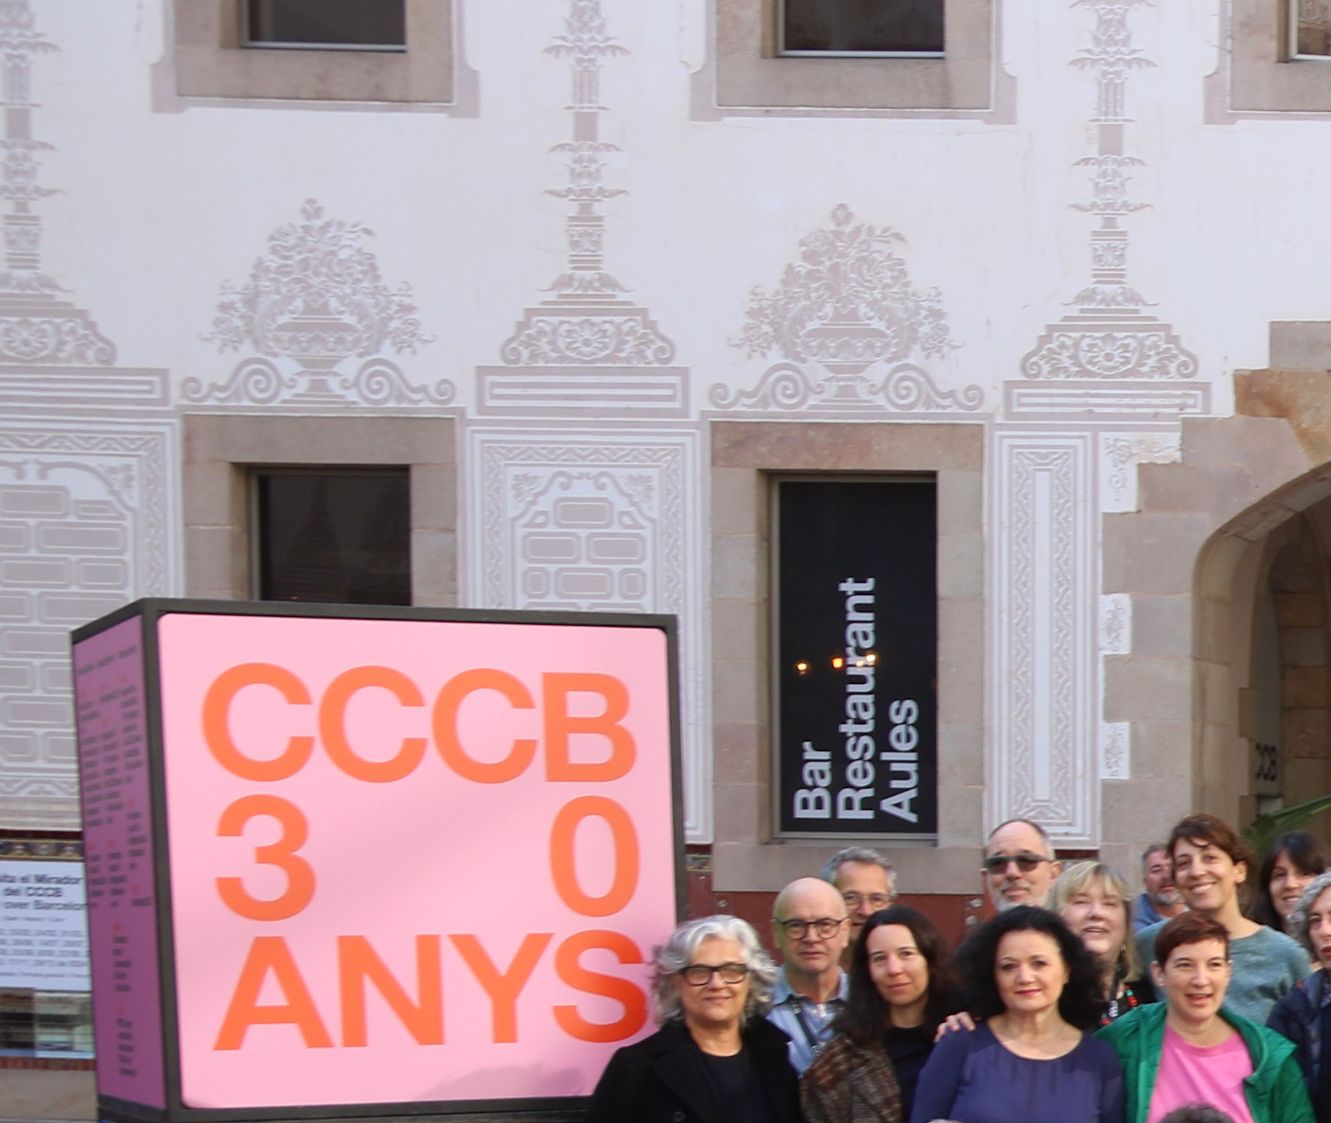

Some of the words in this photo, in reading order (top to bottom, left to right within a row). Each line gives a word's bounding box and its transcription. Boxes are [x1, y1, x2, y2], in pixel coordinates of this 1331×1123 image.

[201, 662, 638, 784] CCCB
[837, 577, 876, 820] Restaurant
[793, 741, 832, 819] Bar
[880, 698, 919, 823] Aules
[215, 794, 317, 921] 3
[549, 795, 640, 918] 0
[212, 929, 650, 1051] ANYS
